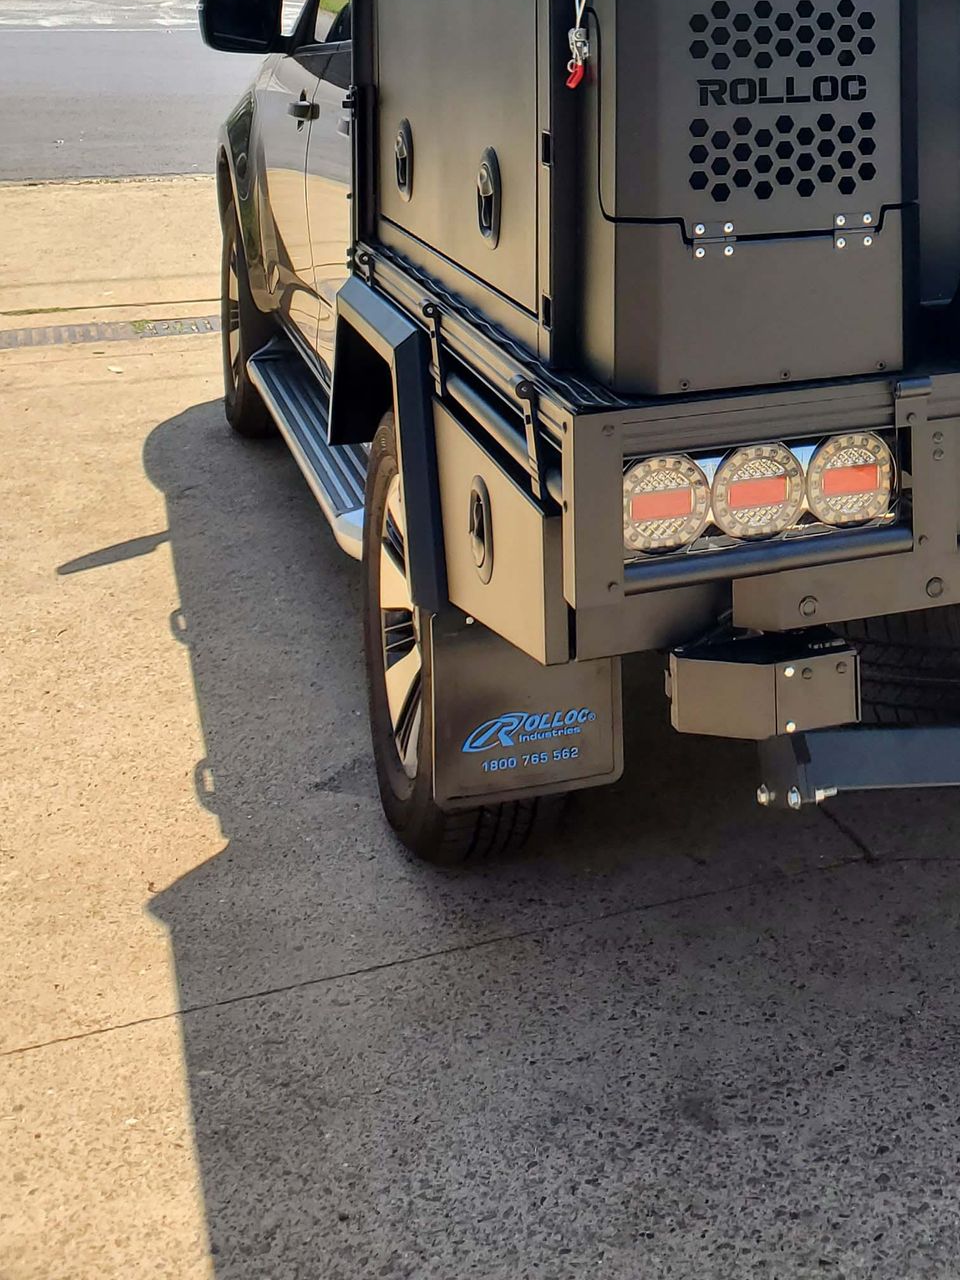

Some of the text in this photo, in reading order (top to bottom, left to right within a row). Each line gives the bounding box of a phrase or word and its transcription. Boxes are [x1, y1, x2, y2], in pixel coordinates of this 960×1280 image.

[696, 74, 867, 107] ROLLOC
[518, 726, 581, 743] Industries
[482, 747, 579, 772] 1800 765 562
